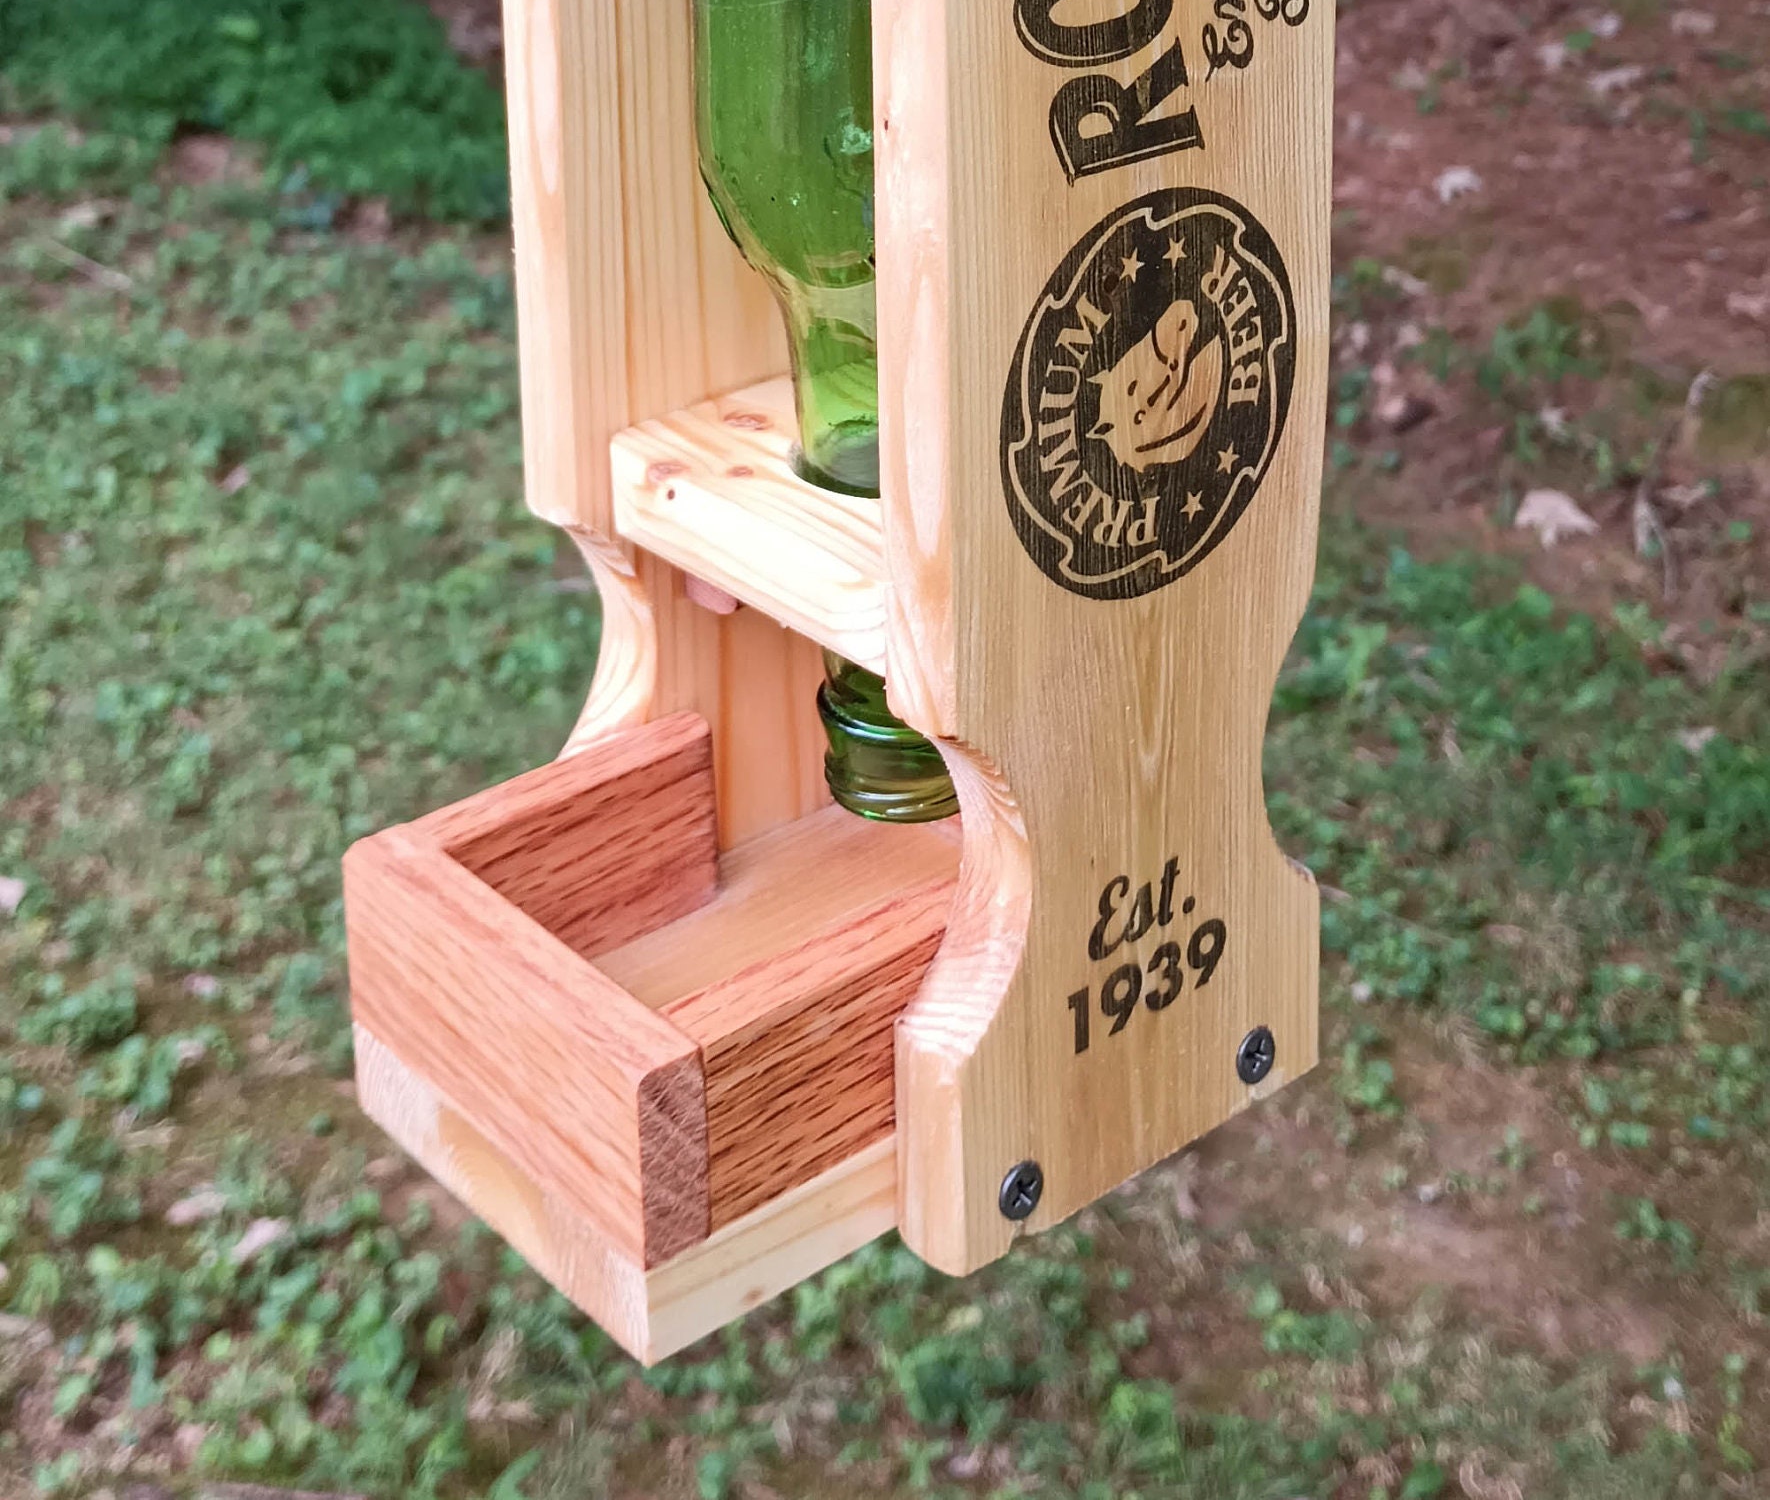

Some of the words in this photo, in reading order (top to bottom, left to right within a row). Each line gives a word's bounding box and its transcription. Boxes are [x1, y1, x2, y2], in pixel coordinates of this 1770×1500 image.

[1201, 243, 1265, 410] BEER
[1037, 292, 1161, 549] PREMIUM
[1087, 855, 1197, 962] Est.
[1067, 917, 1228, 1055] 1939
